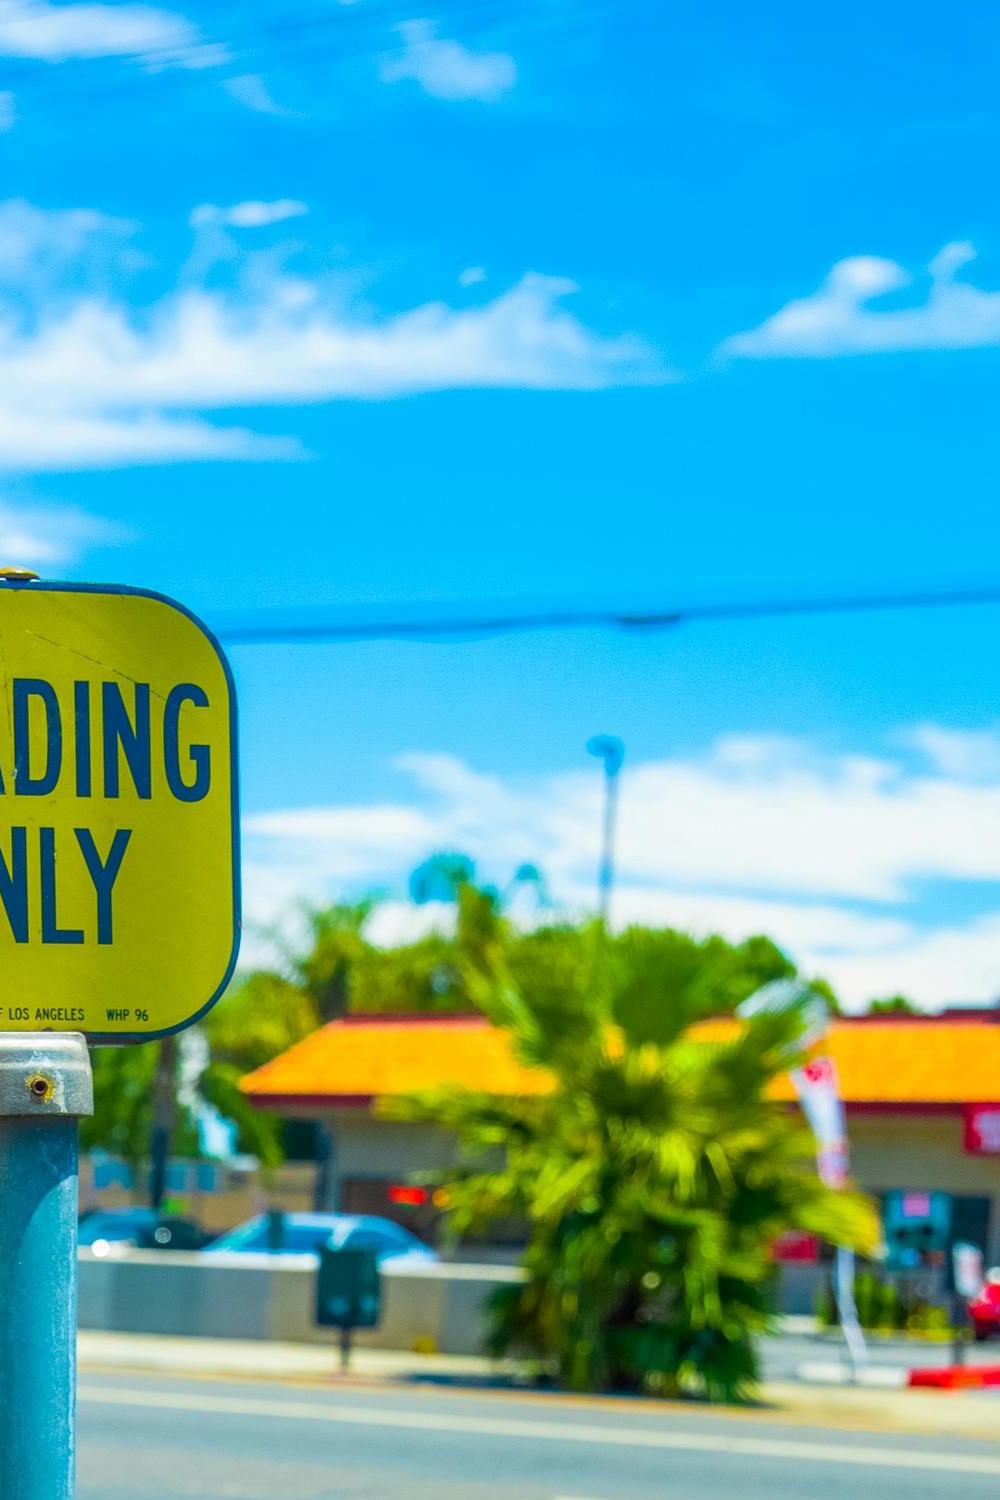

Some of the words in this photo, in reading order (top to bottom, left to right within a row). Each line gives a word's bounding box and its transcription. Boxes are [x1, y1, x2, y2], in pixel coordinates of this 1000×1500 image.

[8, 1006, 30, 1022] LOS
[34, 1006, 85, 1022] ANGELES
[105, 1008, 129, 1022] WHP
[134, 1008, 149, 1022] 96
